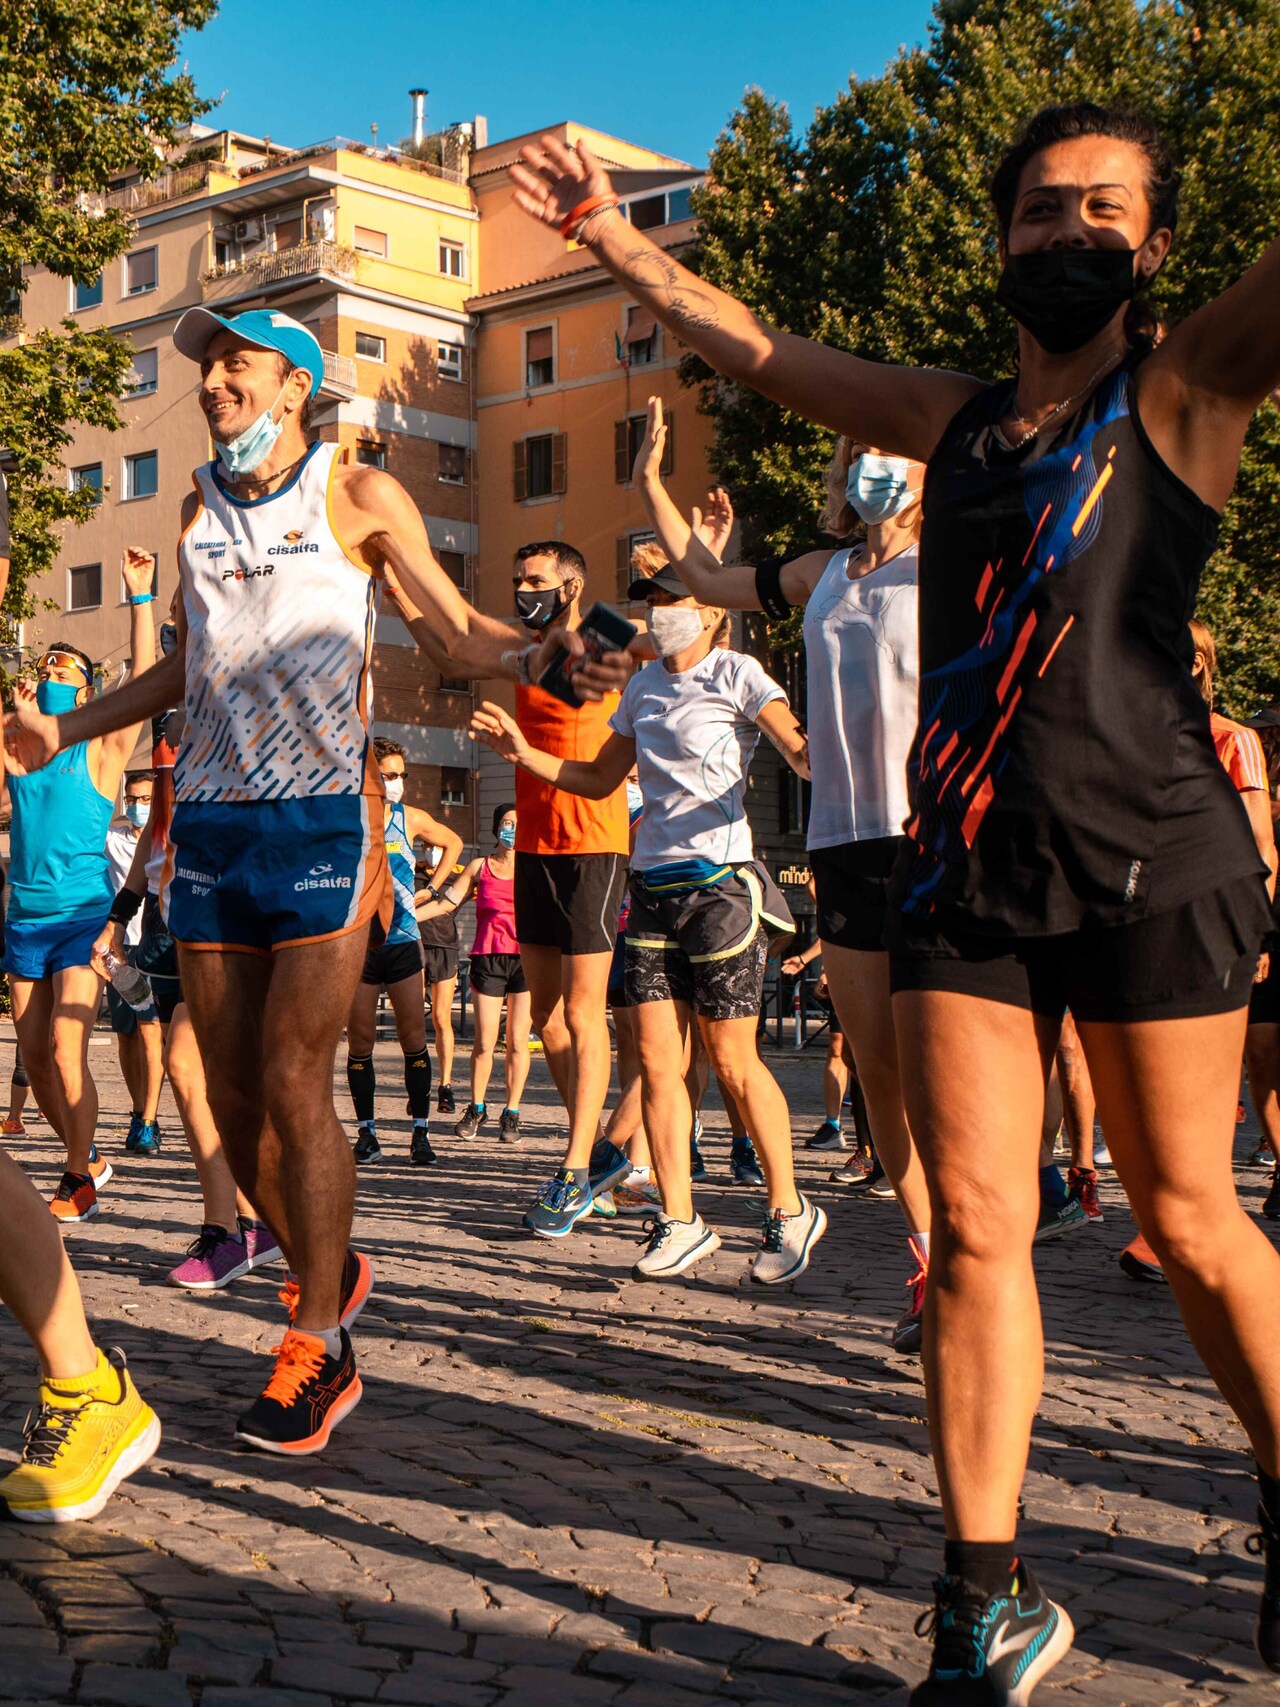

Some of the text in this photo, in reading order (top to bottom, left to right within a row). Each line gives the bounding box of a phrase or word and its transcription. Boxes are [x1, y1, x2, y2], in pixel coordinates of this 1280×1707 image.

[208, 550, 226, 559] SPORT
[267, 543, 319, 555] cisalfa
[177, 867, 216, 885] ALCATERRA
[294, 876, 351, 892] cisalfa
